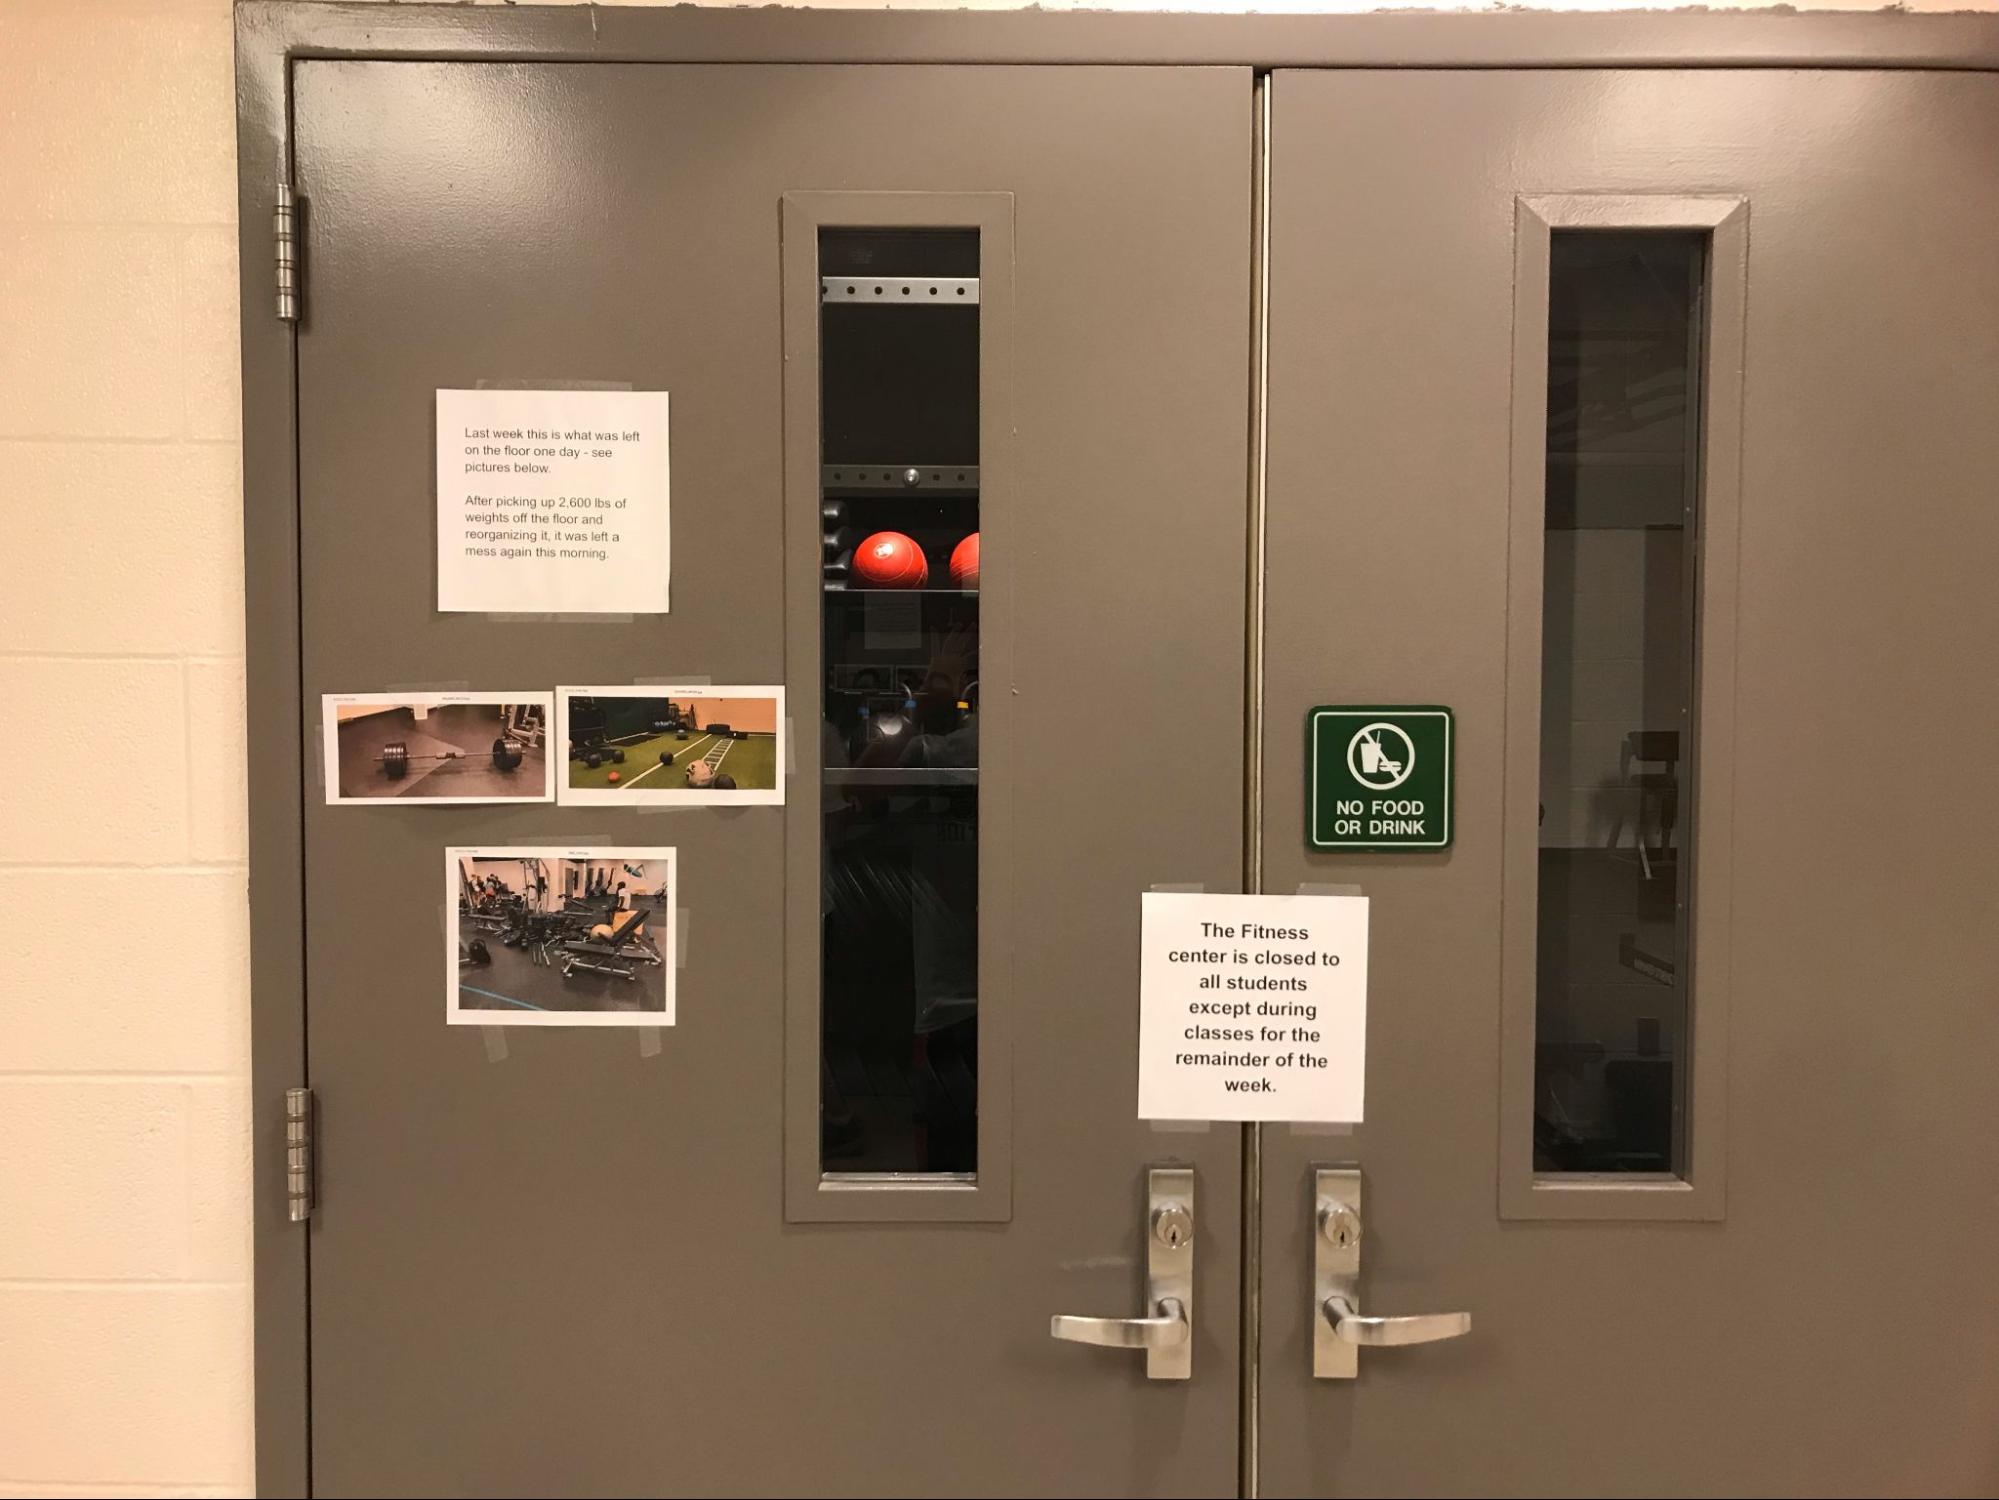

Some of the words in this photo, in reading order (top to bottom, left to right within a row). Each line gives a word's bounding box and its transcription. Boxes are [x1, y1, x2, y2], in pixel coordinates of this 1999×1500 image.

[465, 428, 489, 438] Last
[493, 429, 523, 438] week
[528, 429, 547, 439] this
[551, 430, 560, 440] is
[565, 430, 591, 440] what
[623, 431, 639, 441] left
[465, 447, 479, 455] on
[483, 445, 501, 455] the
[504, 445, 530, 456] floor
[534, 448, 555, 456] one
[559, 447, 580, 459] day
[465, 462, 510, 473] pictures
[514, 462, 551, 473] below.
[465, 496, 492, 506] After
[496, 496, 536, 509] picking
[541, 499, 555, 509] up
[559, 497, 591, 508] 2,600
[595, 498, 611, 508] lbs
[615, 498, 626, 508] of
[465, 512, 509, 524] weights
[513, 513, 527, 523] off
[531, 514, 549, 523] the
[553, 514, 578, 524] floor
[582, 515, 603, 525] and
[465, 529, 537, 541] reorganizing
[541, 531, 550, 542] it,
[555, 531, 561, 540] it
[565, 533, 588, 541] was
[591, 532, 608, 542] left
[612, 534, 619, 542] a
[466, 548, 496, 556] mess
[500, 548, 531, 559] again
[536, 548, 556, 557] this
[560, 550, 608, 561] morning.
[1337, 800, 1363, 815] NO
[1372, 800, 1424, 815] FOOD
[1335, 820, 1361, 835] OR
[1370, 820, 1425, 834] DRINK
[1201, 923, 1234, 938] The
[1242, 924, 1308, 940] Fitness
[1169, 950, 1227, 963] center
[1234, 950, 1248, 964] is
[1255, 950, 1315, 965] closed
[1322, 953, 1339, 966] to
[1200, 974, 1220, 988] all
[1227, 976, 1307, 991] students
[1189, 1002, 1250, 1018] except
[1257, 1001, 1316, 1020] during
[1185, 1025, 1254, 1041] classes
[1261, 1027, 1286, 1041] for
[1292, 1027, 1320, 1042] the
[1176, 1051, 1270, 1066] remainder
[1276, 1053, 1294, 1067] of
[1299, 1053, 1327, 1068] the
[1225, 1078, 1276, 1092] week.
